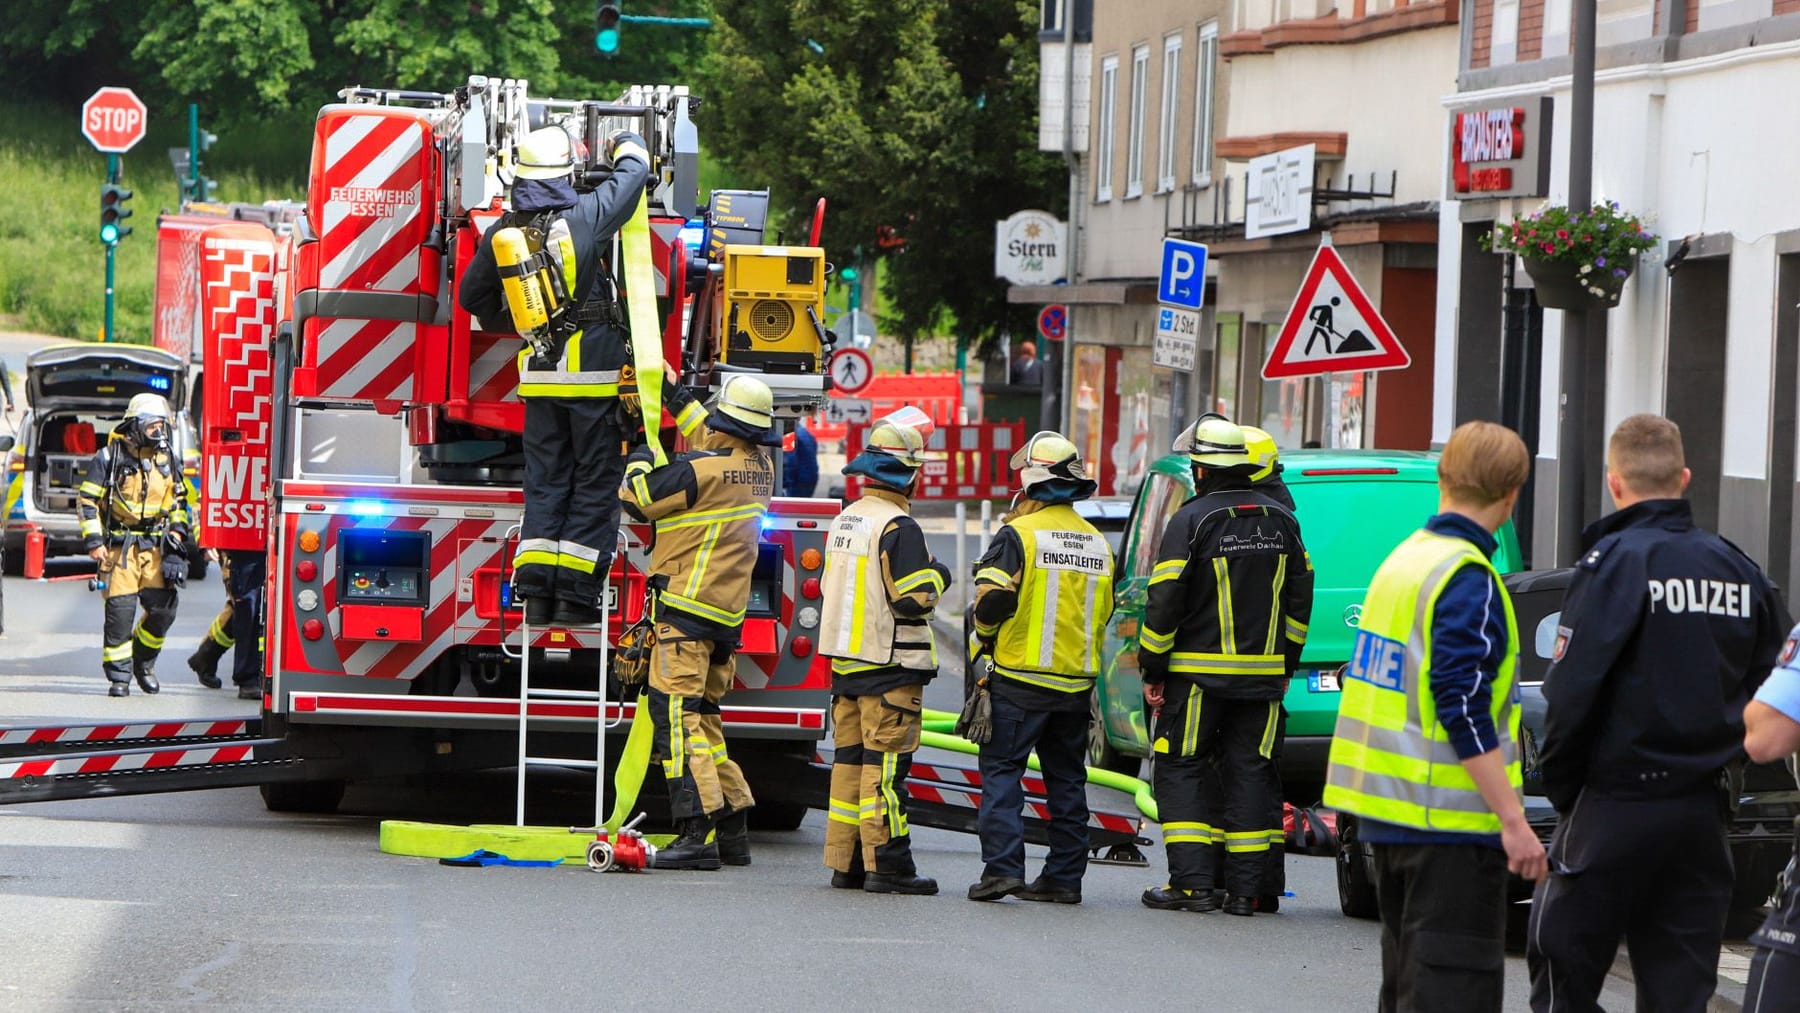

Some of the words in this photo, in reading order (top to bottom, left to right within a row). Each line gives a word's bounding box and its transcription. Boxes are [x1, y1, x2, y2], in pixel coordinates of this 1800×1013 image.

[89, 106, 140, 134] STOP
[1458, 107, 1518, 162] BROASTERS
[330, 187, 415, 205] FEUERWEHR
[351, 203, 394, 217] ESSEN
[1008, 239, 1057, 257] Stern
[1168, 249, 1195, 296] P
[1173, 313, 1180, 333] 2
[1051, 532, 1093, 542] FEUERWEHR
[1063, 541, 1084, 550] ESSEN
[1219, 543, 1256, 553] Feuerwehr
[1257, 542, 1284, 550] Dachau
[1043, 552, 1104, 571] EINSATZLEITER
[1648, 578, 1751, 618] POLIZEI
[1320, 672, 1330, 688] E
